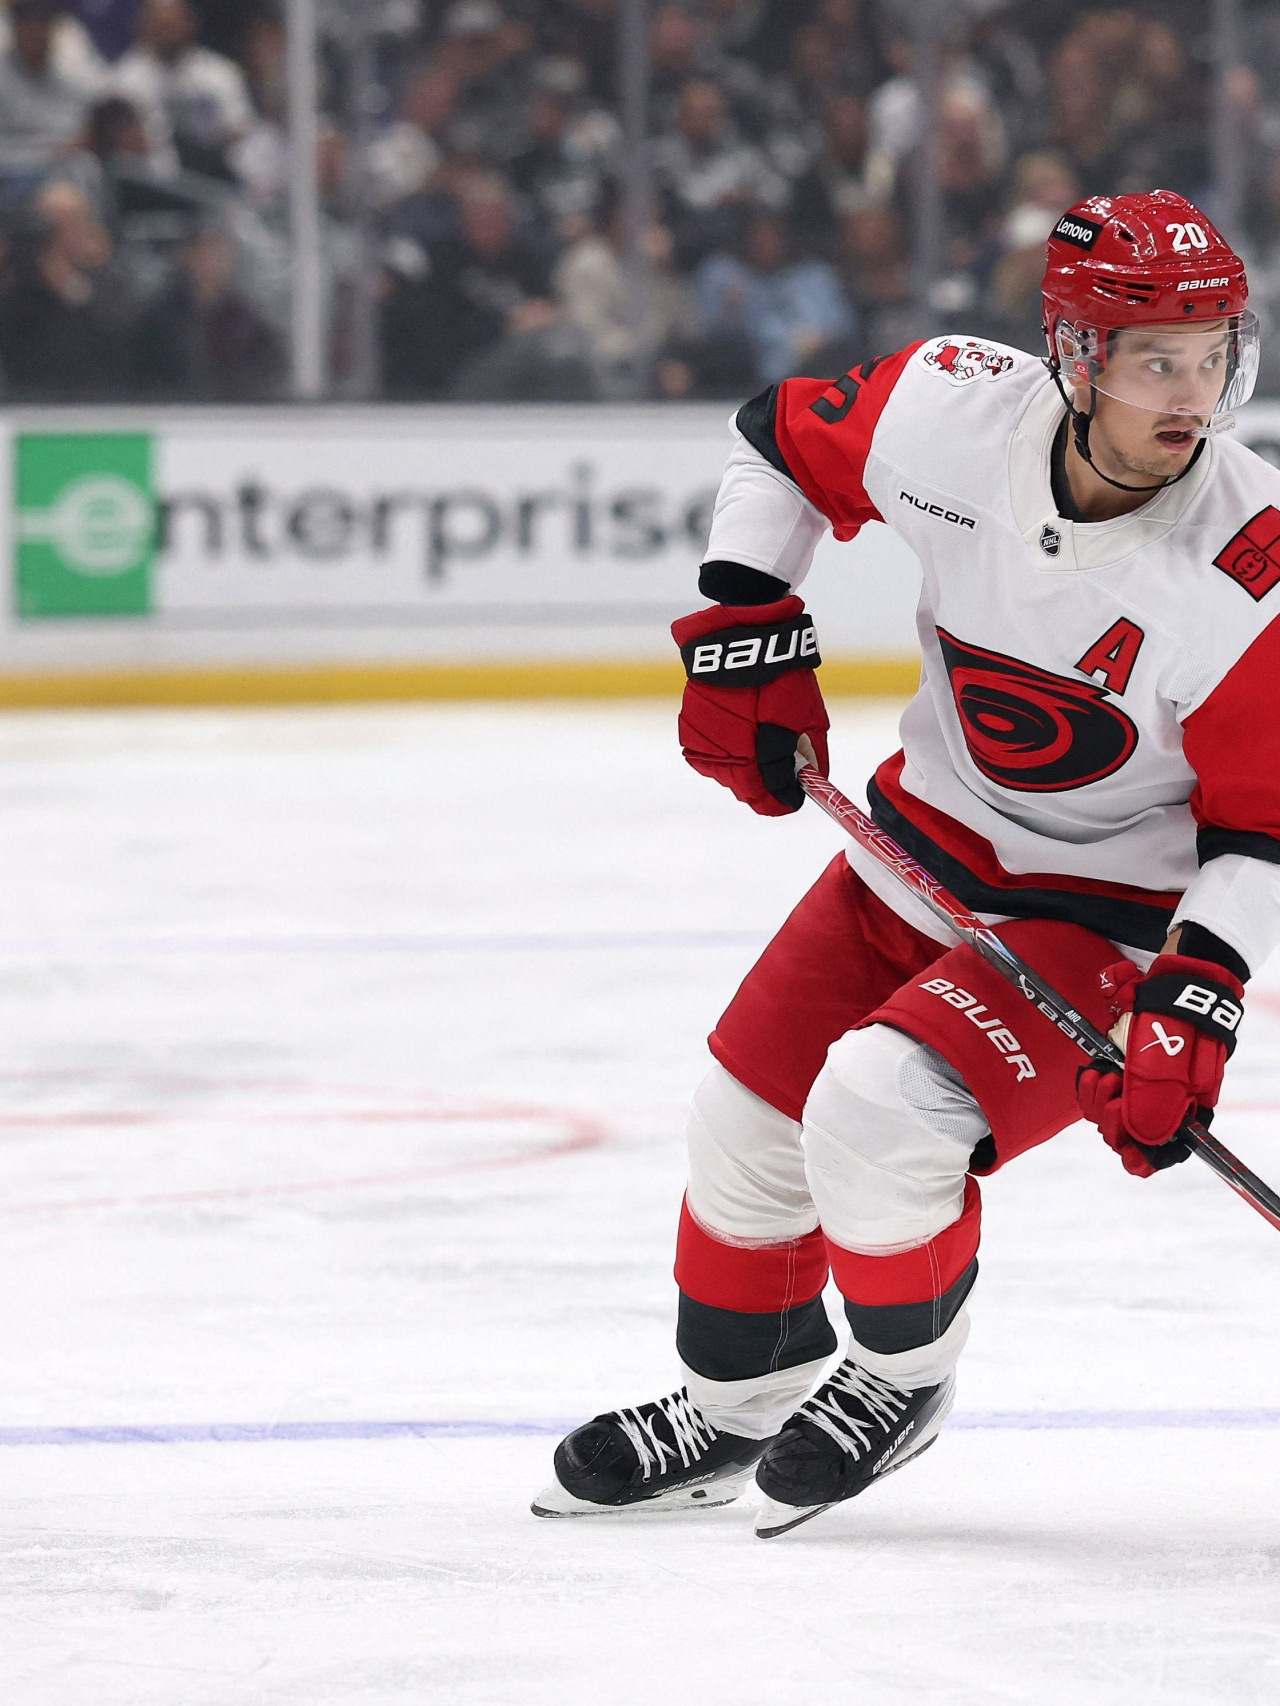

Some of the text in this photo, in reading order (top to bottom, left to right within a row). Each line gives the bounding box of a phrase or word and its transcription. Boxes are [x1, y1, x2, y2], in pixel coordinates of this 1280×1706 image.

[1056, 217, 1093, 243] Lenovo
[1165, 222, 1209, 251] 20
[899, 490, 976, 529] NUCOR
[1043, 536, 1059, 547] NHL
[1073, 616, 1145, 697] A
[1064, 1009, 1082, 1023] AHO
